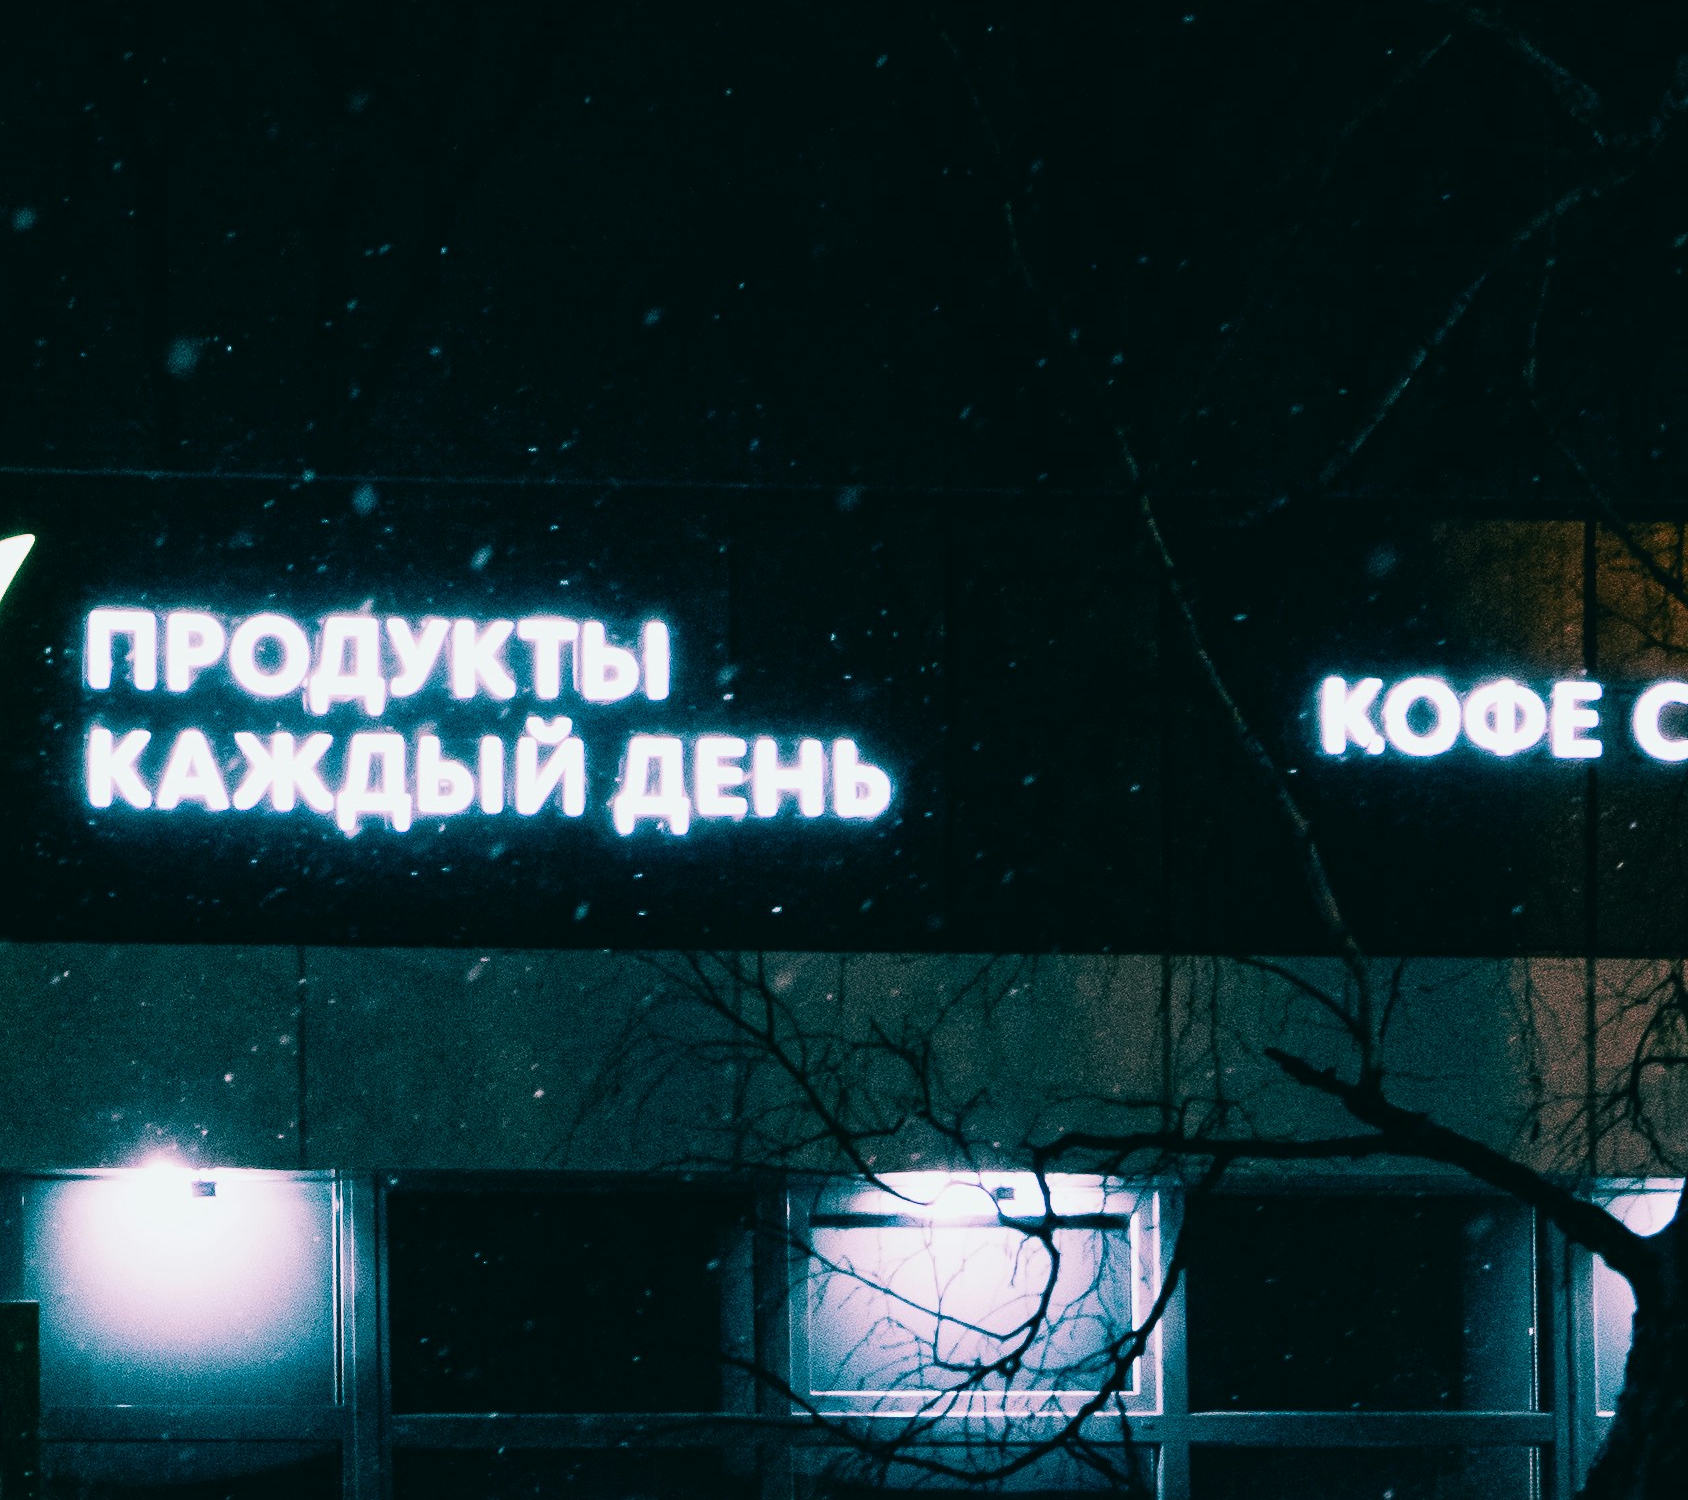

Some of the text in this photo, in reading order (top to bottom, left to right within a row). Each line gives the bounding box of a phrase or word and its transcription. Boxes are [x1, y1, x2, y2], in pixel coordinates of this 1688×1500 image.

[82, 606, 670, 716] ПРОДУКТЫ
[1319, 675, 1603, 759] КОФЕ
[85, 716, 892, 836] КАЖДЫЙ ДЕНЬ
